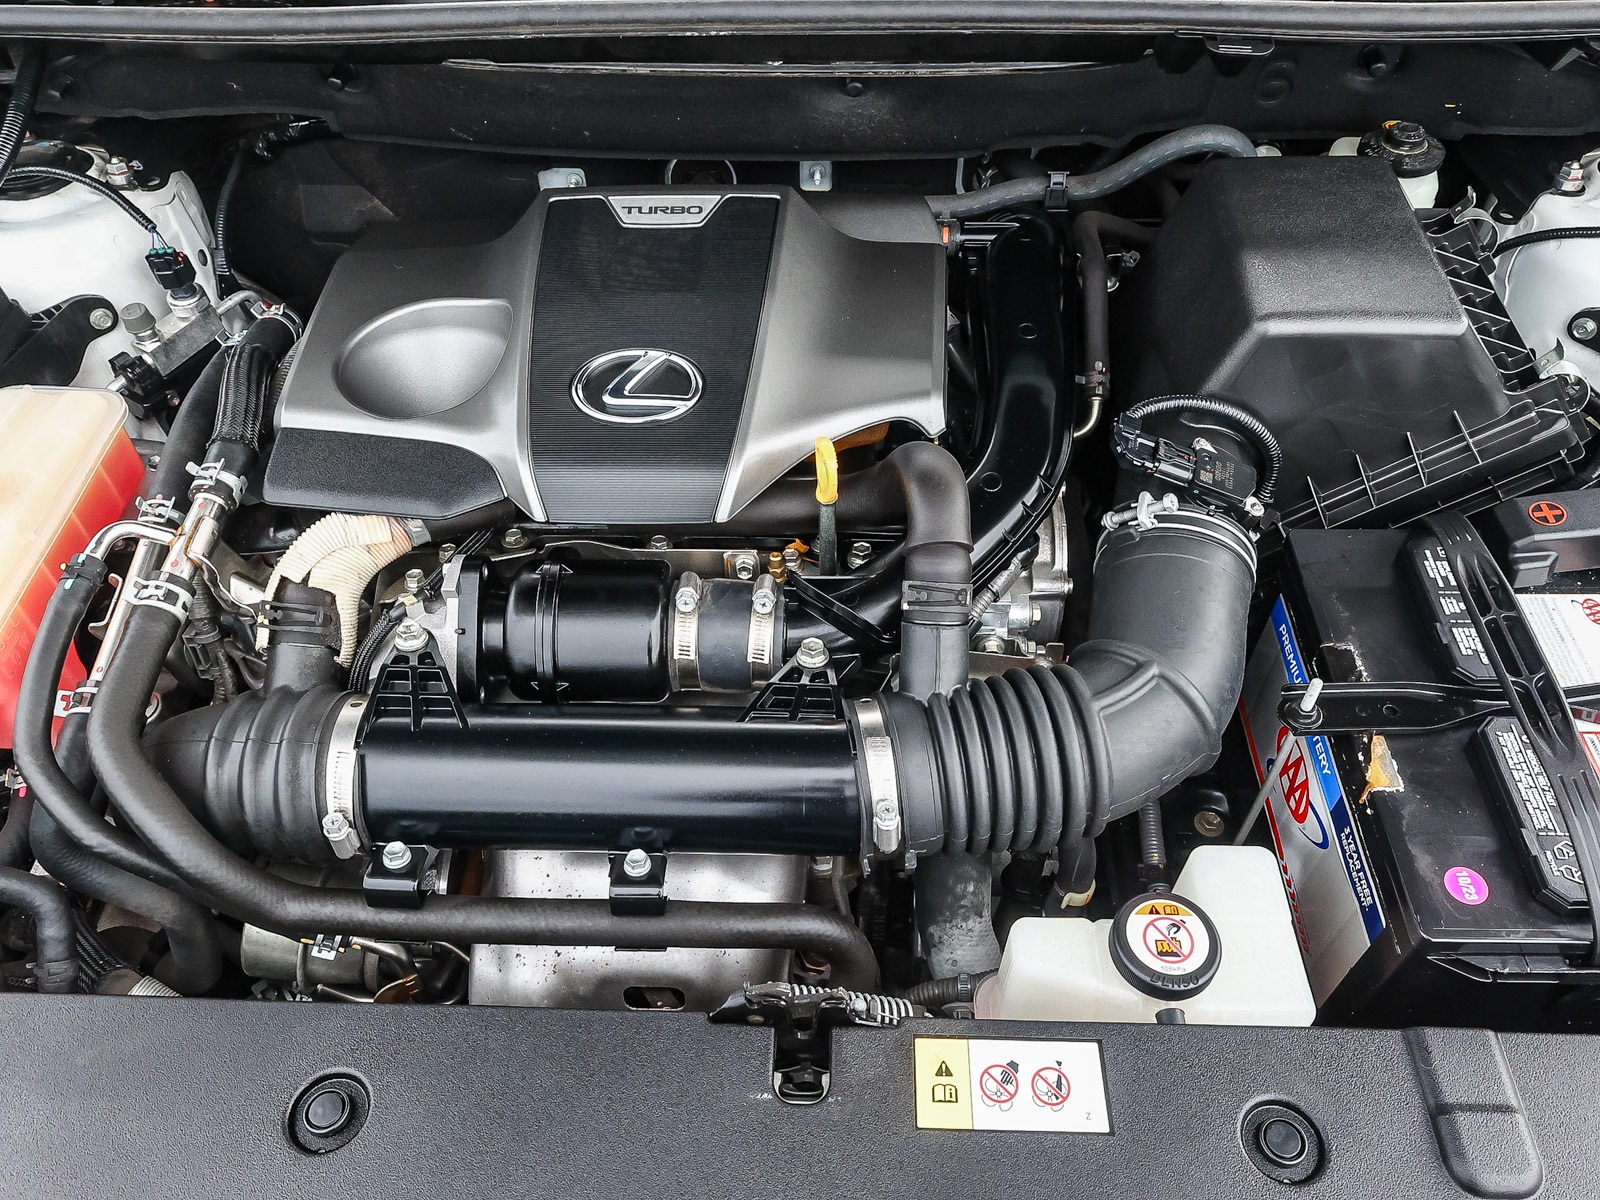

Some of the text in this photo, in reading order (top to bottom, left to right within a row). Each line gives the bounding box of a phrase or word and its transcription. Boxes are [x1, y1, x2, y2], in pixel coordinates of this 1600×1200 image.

[621, 205, 704, 215] TURBO
[1279, 623, 1304, 684] PREMIU
[1312, 735, 1332, 776] TERY
[1344, 825, 1374, 907] 3 YEAR FREE
[1544, 849, 1561, 877] RECYCLE
[1455, 869, 1480, 901] 10/23
[1149, 972, 1200, 989] DENSO
[1085, 1111, 1092, 1120] Z
